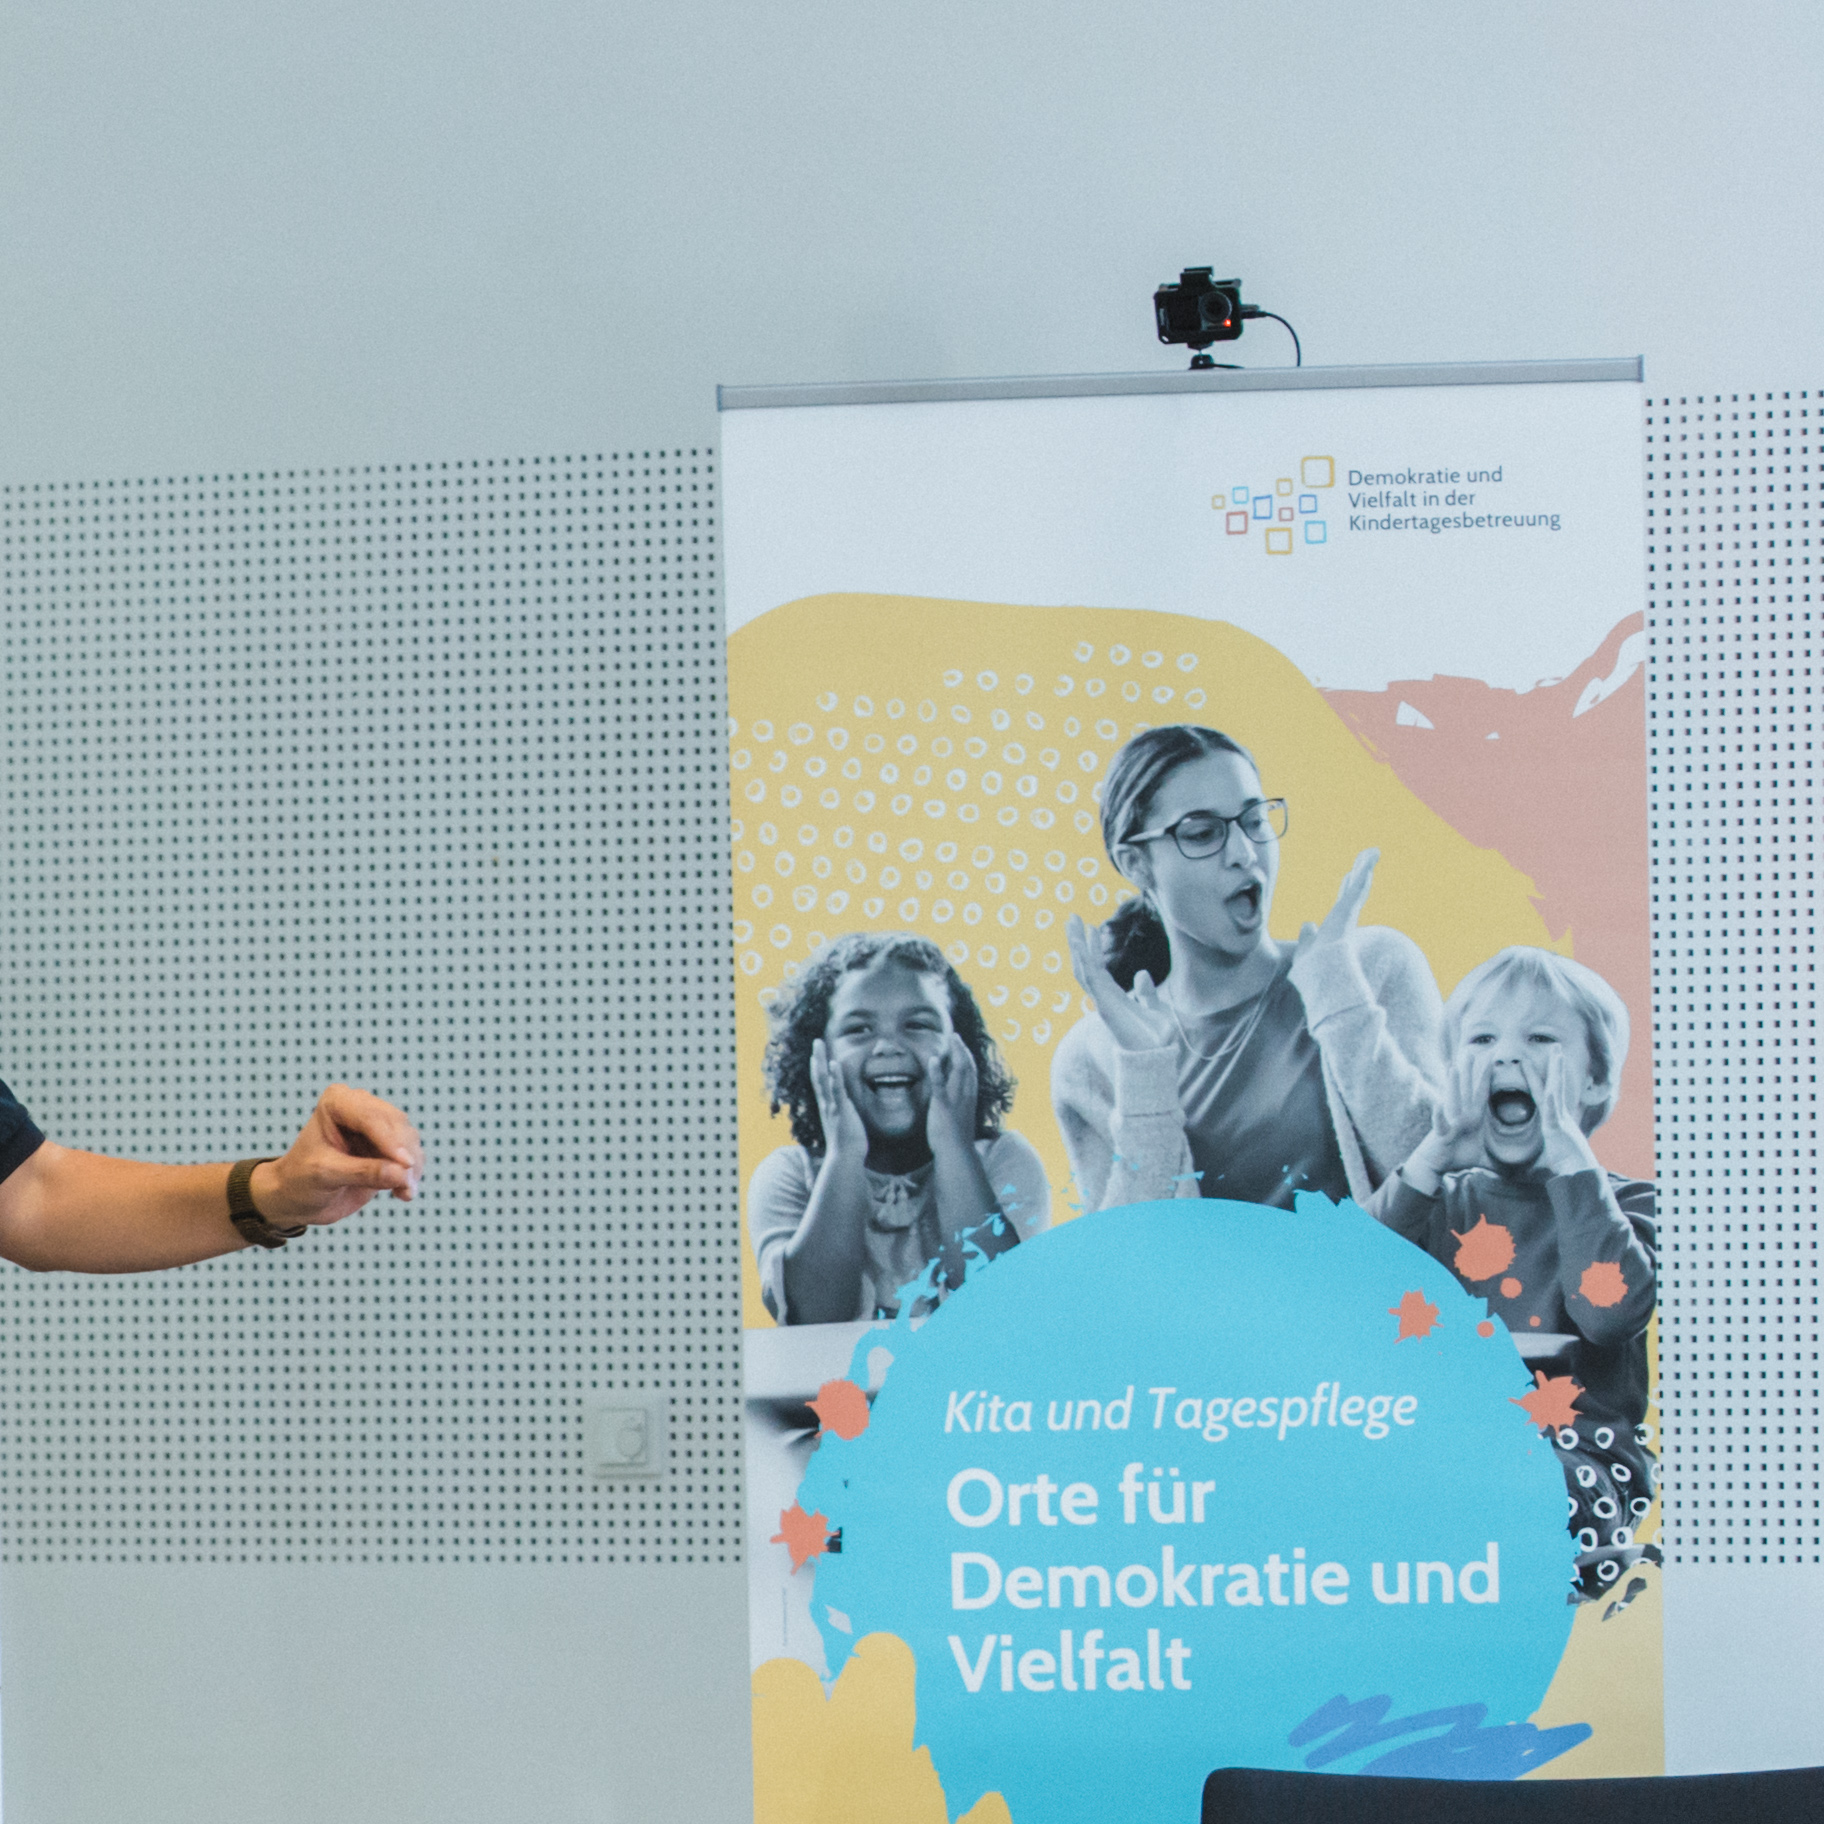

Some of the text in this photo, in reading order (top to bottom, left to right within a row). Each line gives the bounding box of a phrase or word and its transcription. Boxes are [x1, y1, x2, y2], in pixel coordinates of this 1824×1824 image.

[1348, 466, 1503, 486] Demokratie und
[1348, 489, 1475, 508] Vielfalt in der
[1349, 511, 1561, 533] Kindertagesbetreuung
[945, 1381, 1418, 1442] Kita und Tagespflege
[947, 1462, 1215, 1527] Orte für
[951, 1542, 1499, 1610] Demokratie und
[948, 1630, 1191, 1692] Vielfalt
